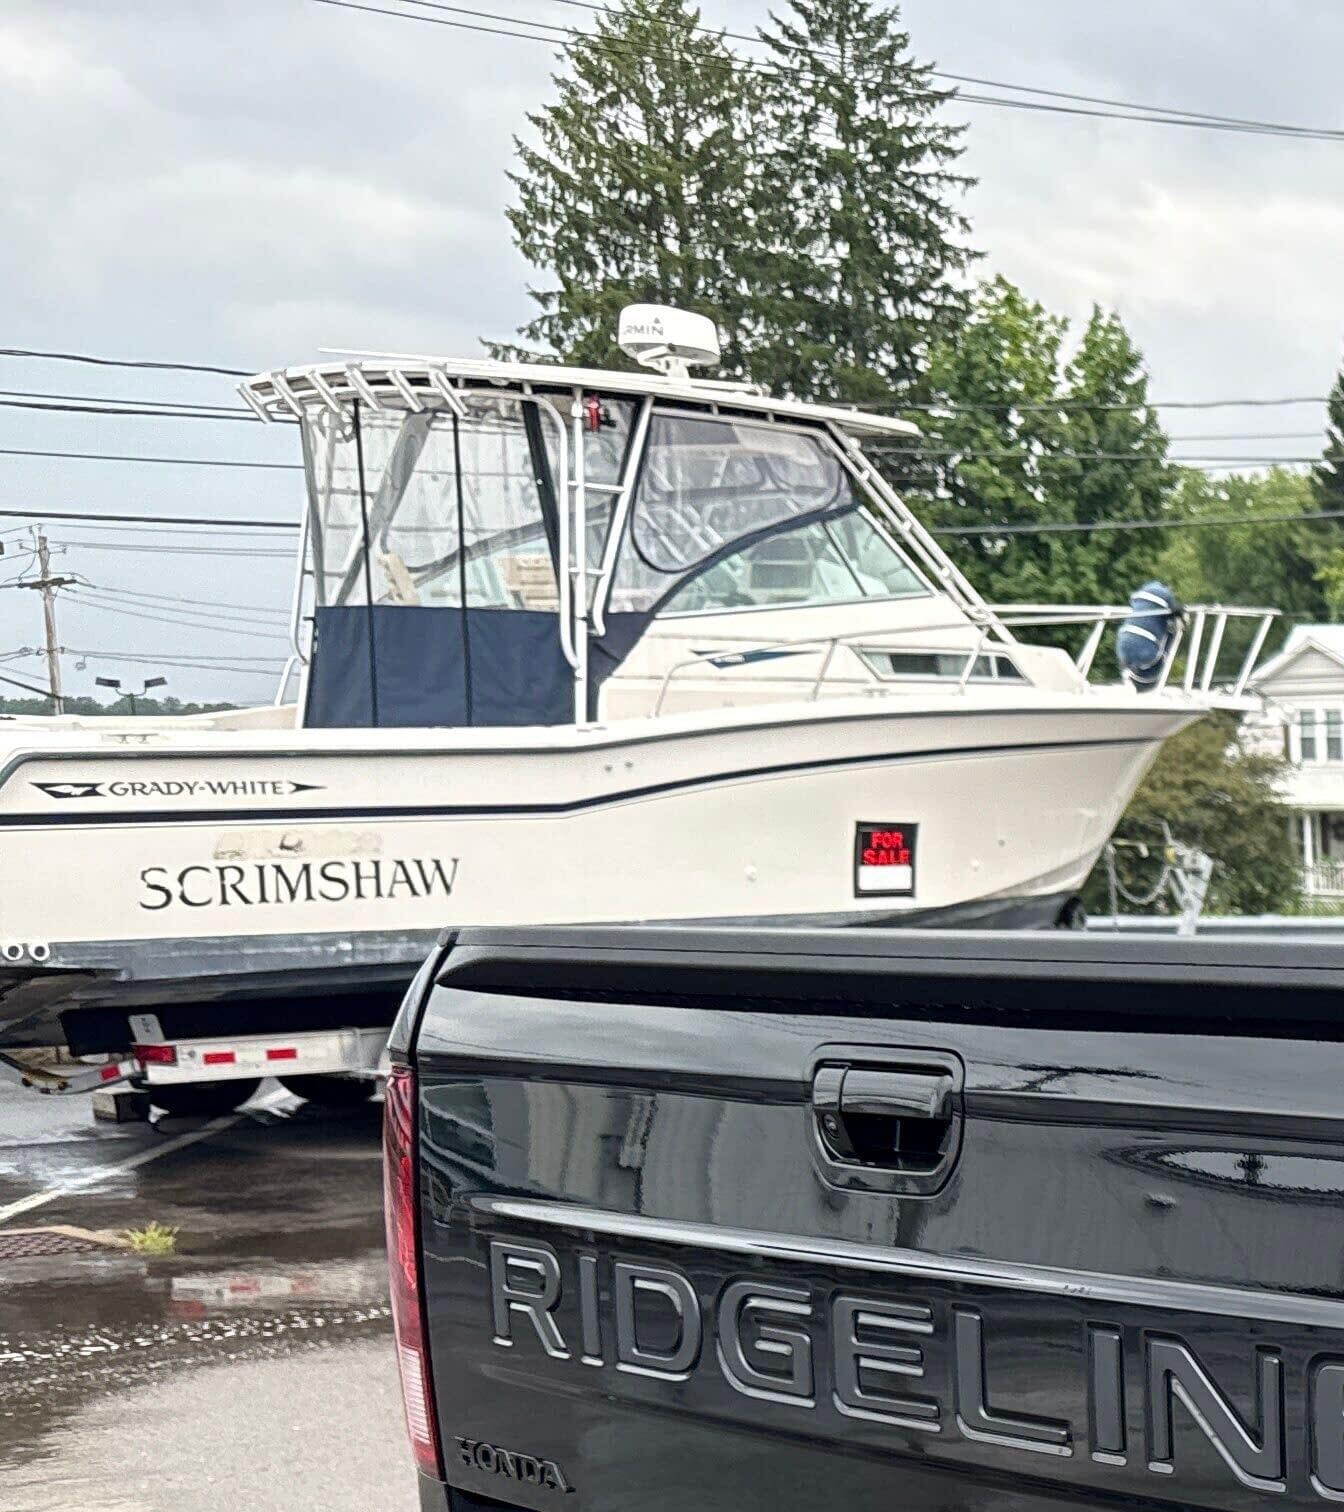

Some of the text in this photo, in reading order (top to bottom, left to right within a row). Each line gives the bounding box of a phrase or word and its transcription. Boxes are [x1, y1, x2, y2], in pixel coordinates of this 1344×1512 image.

[108, 781, 284, 797] GRADY-WHITE
[871, 831, 903, 849] FOR
[863, 849, 910, 865] SALE
[139, 858, 460, 910] SCRIMSHAW
[453, 1435, 570, 1493] HONDA
